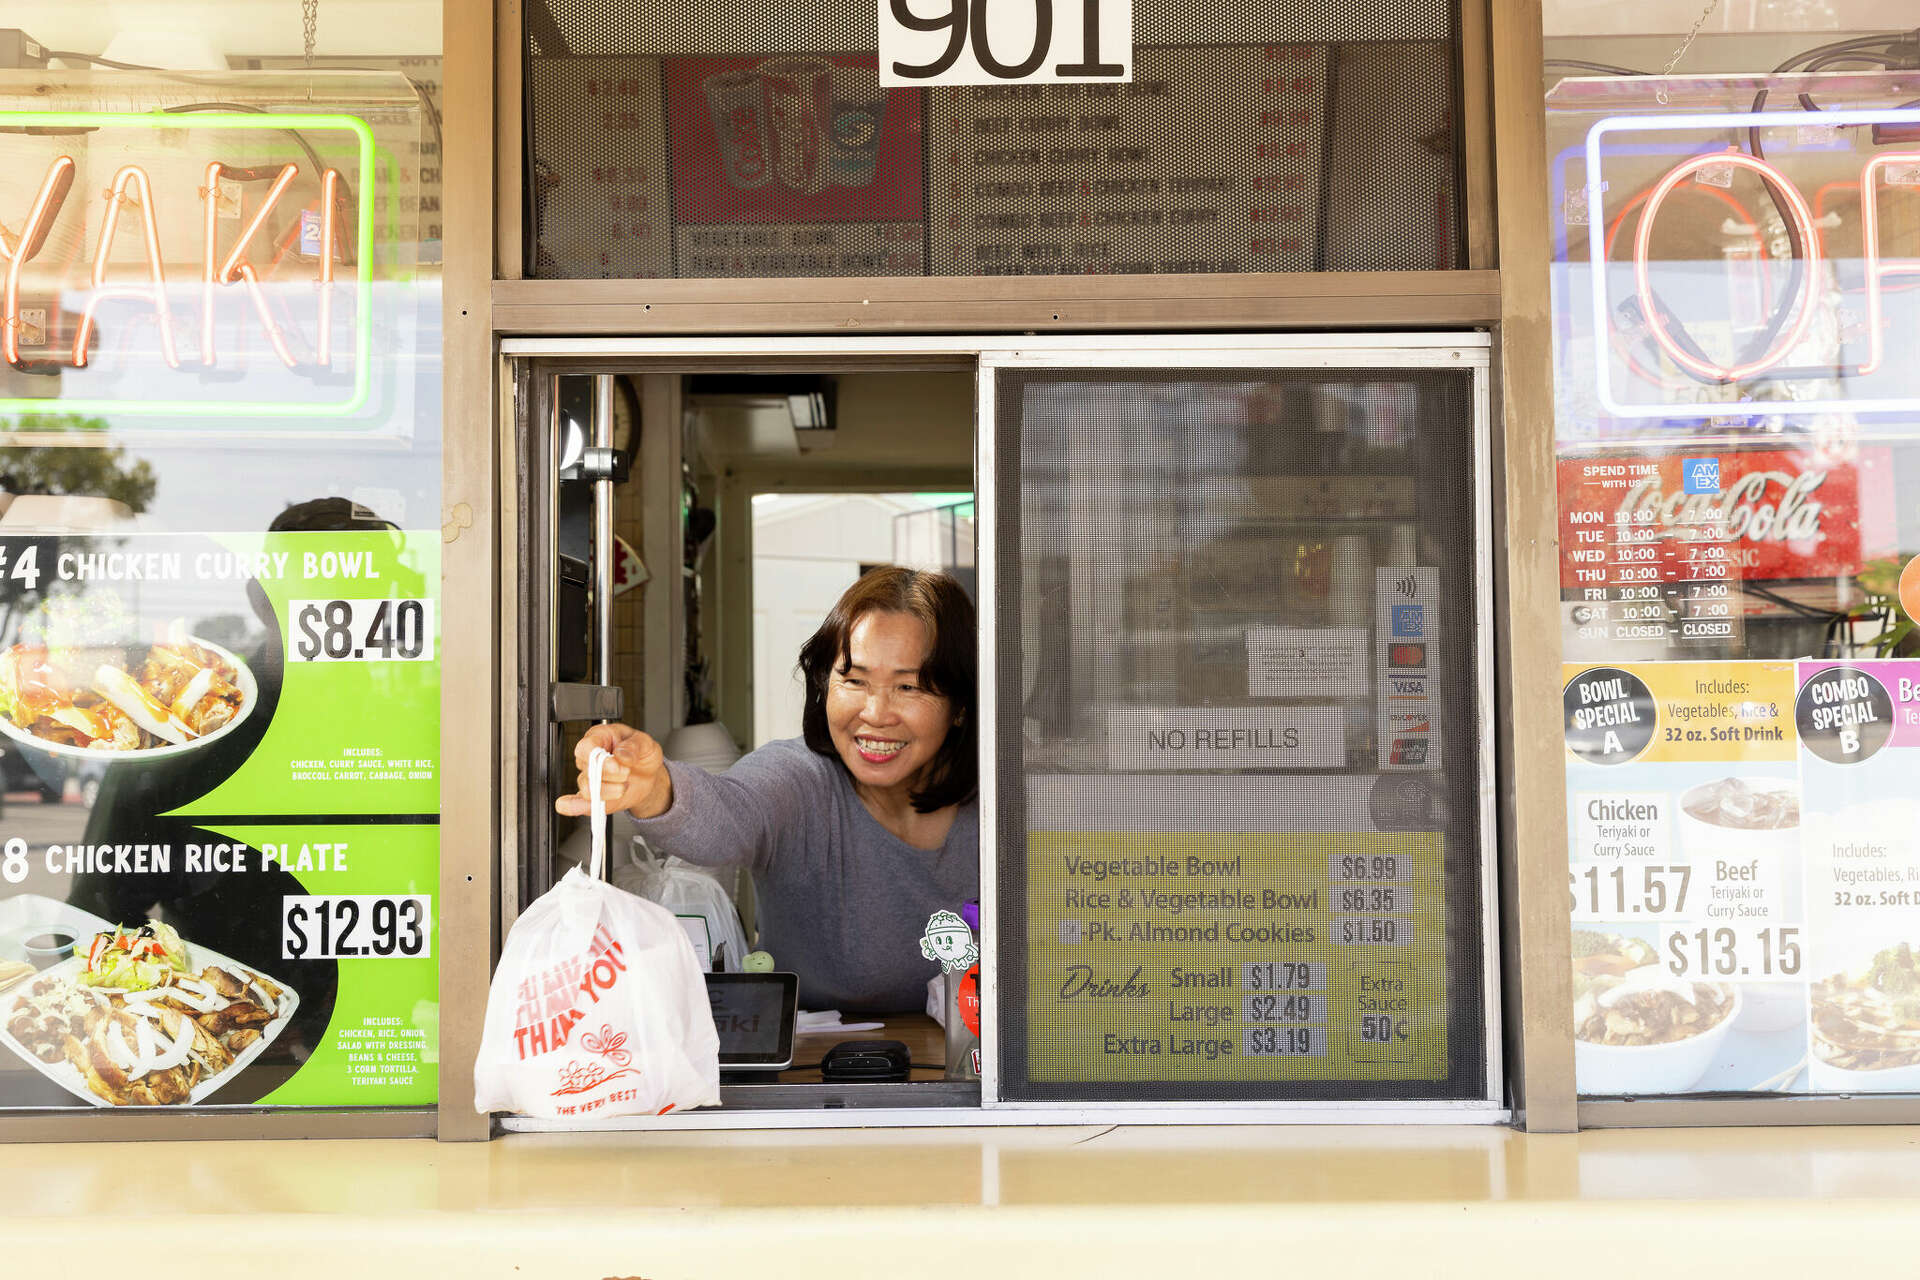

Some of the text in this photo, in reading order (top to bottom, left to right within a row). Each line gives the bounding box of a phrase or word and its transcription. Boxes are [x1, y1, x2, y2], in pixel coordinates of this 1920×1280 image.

[890, 0, 1125, 79] 901
[1583, 464, 1660, 478] SPEND TIME
[1602, 479, 1642, 489] WITH US
[1569, 511, 1605, 524] MON
[1575, 530, 1606, 544] TUE
[56, 551, 182, 581] CHICKEN
[195, 551, 289, 581] CURRY
[302, 551, 380, 580] BOWL
[1572, 549, 1606, 563] WED
[1575, 568, 1607, 582] THU
[1584, 588, 1608, 601] FRI
[1581, 607, 1609, 621] SAT
[297, 599, 425, 661] $8.40
[1578, 623, 1732, 640] SUN CLOSED CLOSED
[1392, 681, 1425, 694] VISA
[1578, 677, 1630, 705] BOWL
[1695, 679, 1750, 695] Includes:
[1811, 676, 1870, 705] COMBO
[1574, 701, 1641, 731] SPECIAL
[1667, 702, 1738, 722] Vegetables,
[1811, 701, 1879, 731] SPECIAL
[1149, 728, 1300, 751] NO REFILLS
[1602, 730, 1625, 755] A
[1664, 726, 1783, 743] 32 oz. Soft Drink
[1839, 730, 1861, 755] B
[1587, 799, 1659, 822] Chicken
[1596, 824, 1651, 842] Teriyaki or
[45, 843, 171, 874] CHICKEN
[185, 843, 247, 873] RICE
[261, 842, 349, 873] PLATE
[1593, 843, 1656, 860] Curry Sauce
[1832, 842, 1888, 859] Includes:
[1064, 855, 1242, 881] Vegetable Bowl
[1342, 856, 1397, 880] $6.99
[1715, 859, 1759, 883] Beef
[1065, 888, 1318, 914] Rice & Vegetable Bowl
[1342, 888, 1395, 912] $6.35
[1710, 885, 1764, 902] Teriyaki or
[1834, 890, 1910, 906] 32 oz. Soft
[1706, 903, 1769, 920] Curry Sauce
[286, 899, 424, 958] $12.93
[1128, 921, 1219, 943] Almond
[1225, 921, 1316, 943] Cookies
[1342, 919, 1396, 943] $1.50
[1668, 927, 1801, 977] $13.15
[1059, 964, 1233, 1000] Drinks Small
[1251, 962, 1311, 990] $1.79
[1360, 975, 1404, 992] Extra
[1169, 1000, 1234, 1026] Large
[1251, 995, 1311, 1022] $2.49
[1357, 995, 1409, 1012] Sauce
[1103, 1033, 1234, 1061] Extra Large
[1251, 1027, 1311, 1055] $3.19
[556, 1088, 638, 1116] THE VERY BEST
